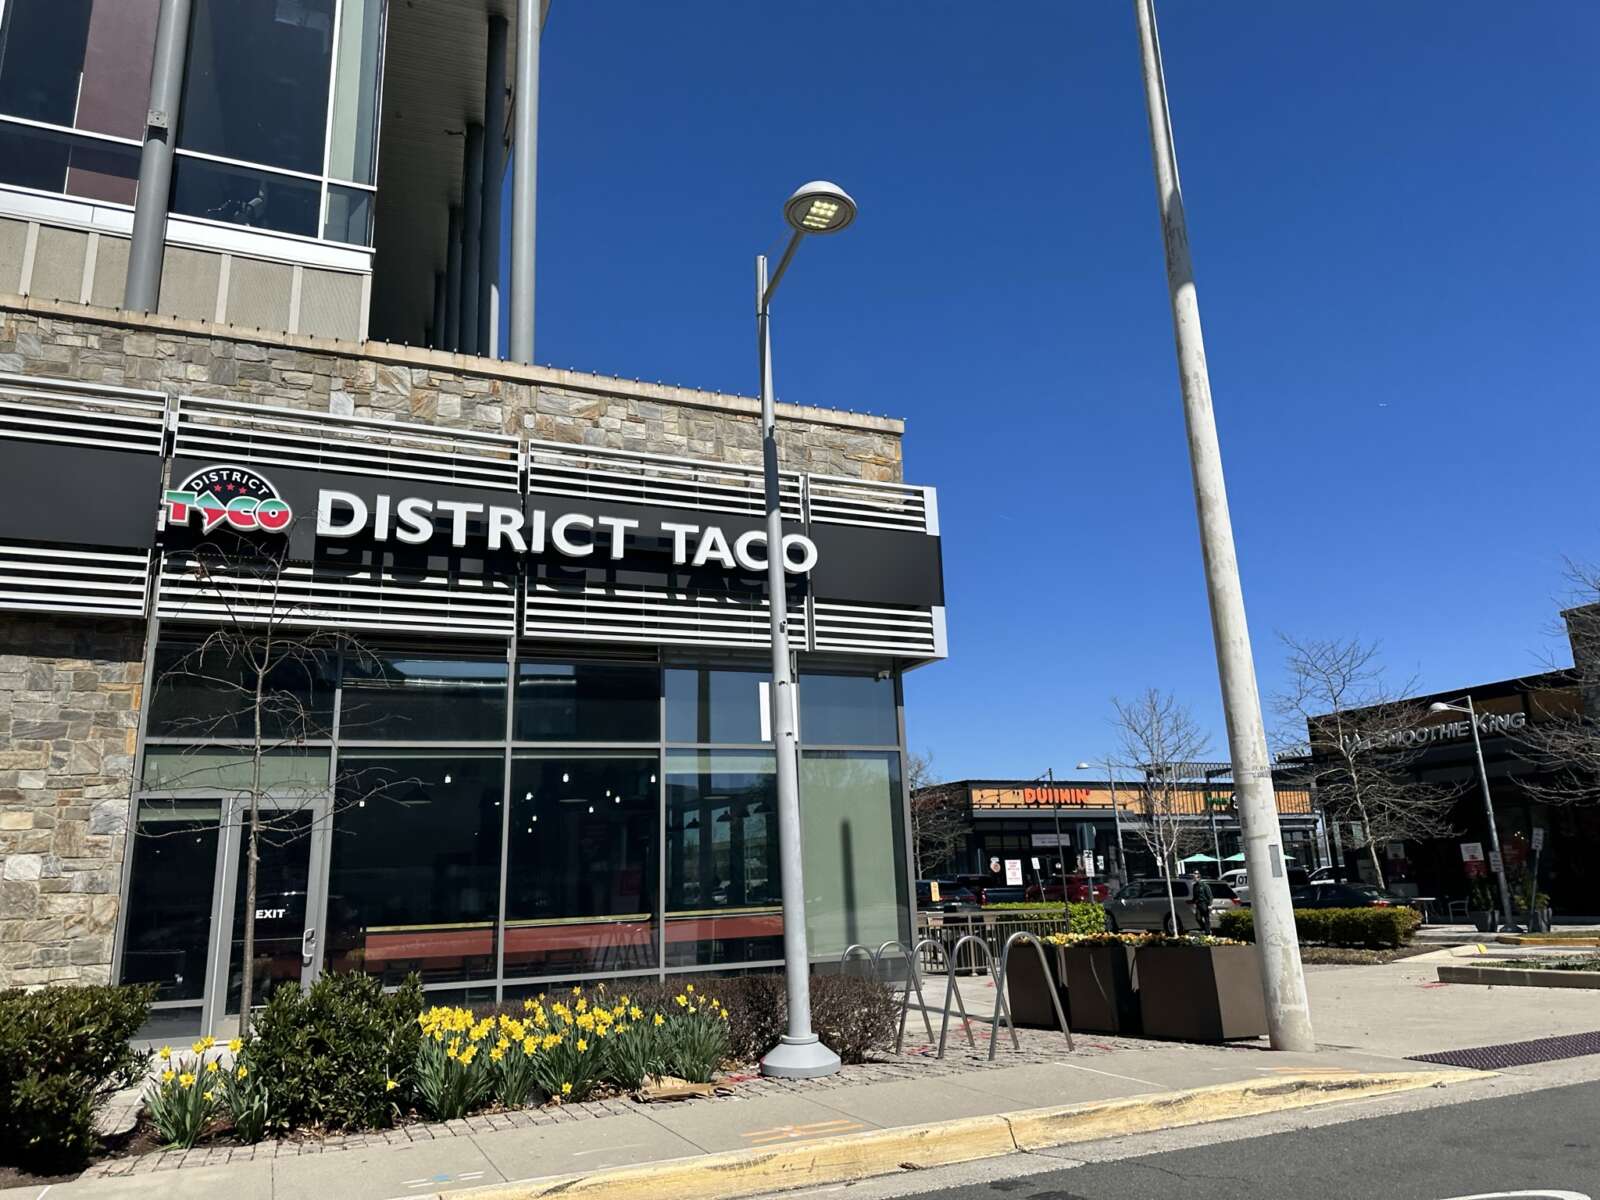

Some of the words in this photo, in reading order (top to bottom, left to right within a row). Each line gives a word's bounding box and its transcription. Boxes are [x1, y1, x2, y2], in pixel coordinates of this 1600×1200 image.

[190, 470, 270, 496] DISTRICT
[164, 490, 293, 536] TACO
[316, 488, 640, 558] DISTRICT
[660, 521, 818, 575] TACO
[1375, 720, 1471, 750] SMOOTHIE
[255, 909, 286, 919] EXIT
